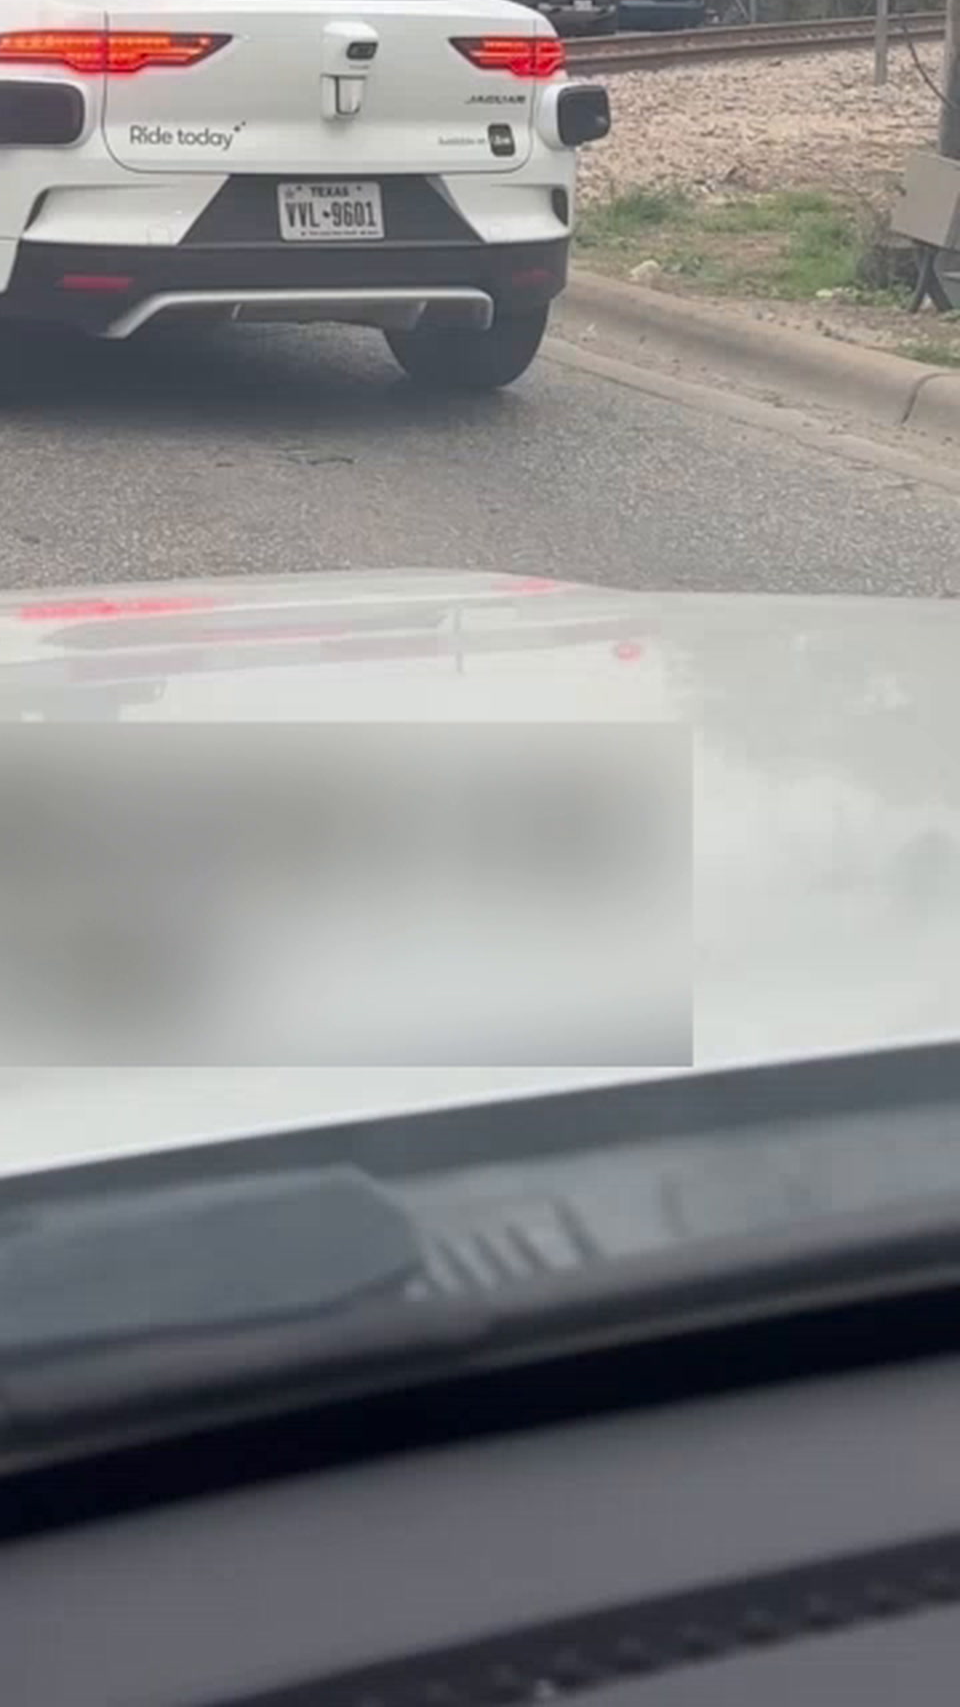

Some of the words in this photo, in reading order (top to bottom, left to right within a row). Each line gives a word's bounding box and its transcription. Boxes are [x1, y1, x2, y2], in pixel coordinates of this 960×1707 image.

[129, 124, 174, 145] Ride
[177, 126, 233, 151] today
[309, 185, 350, 198] TEXAS
